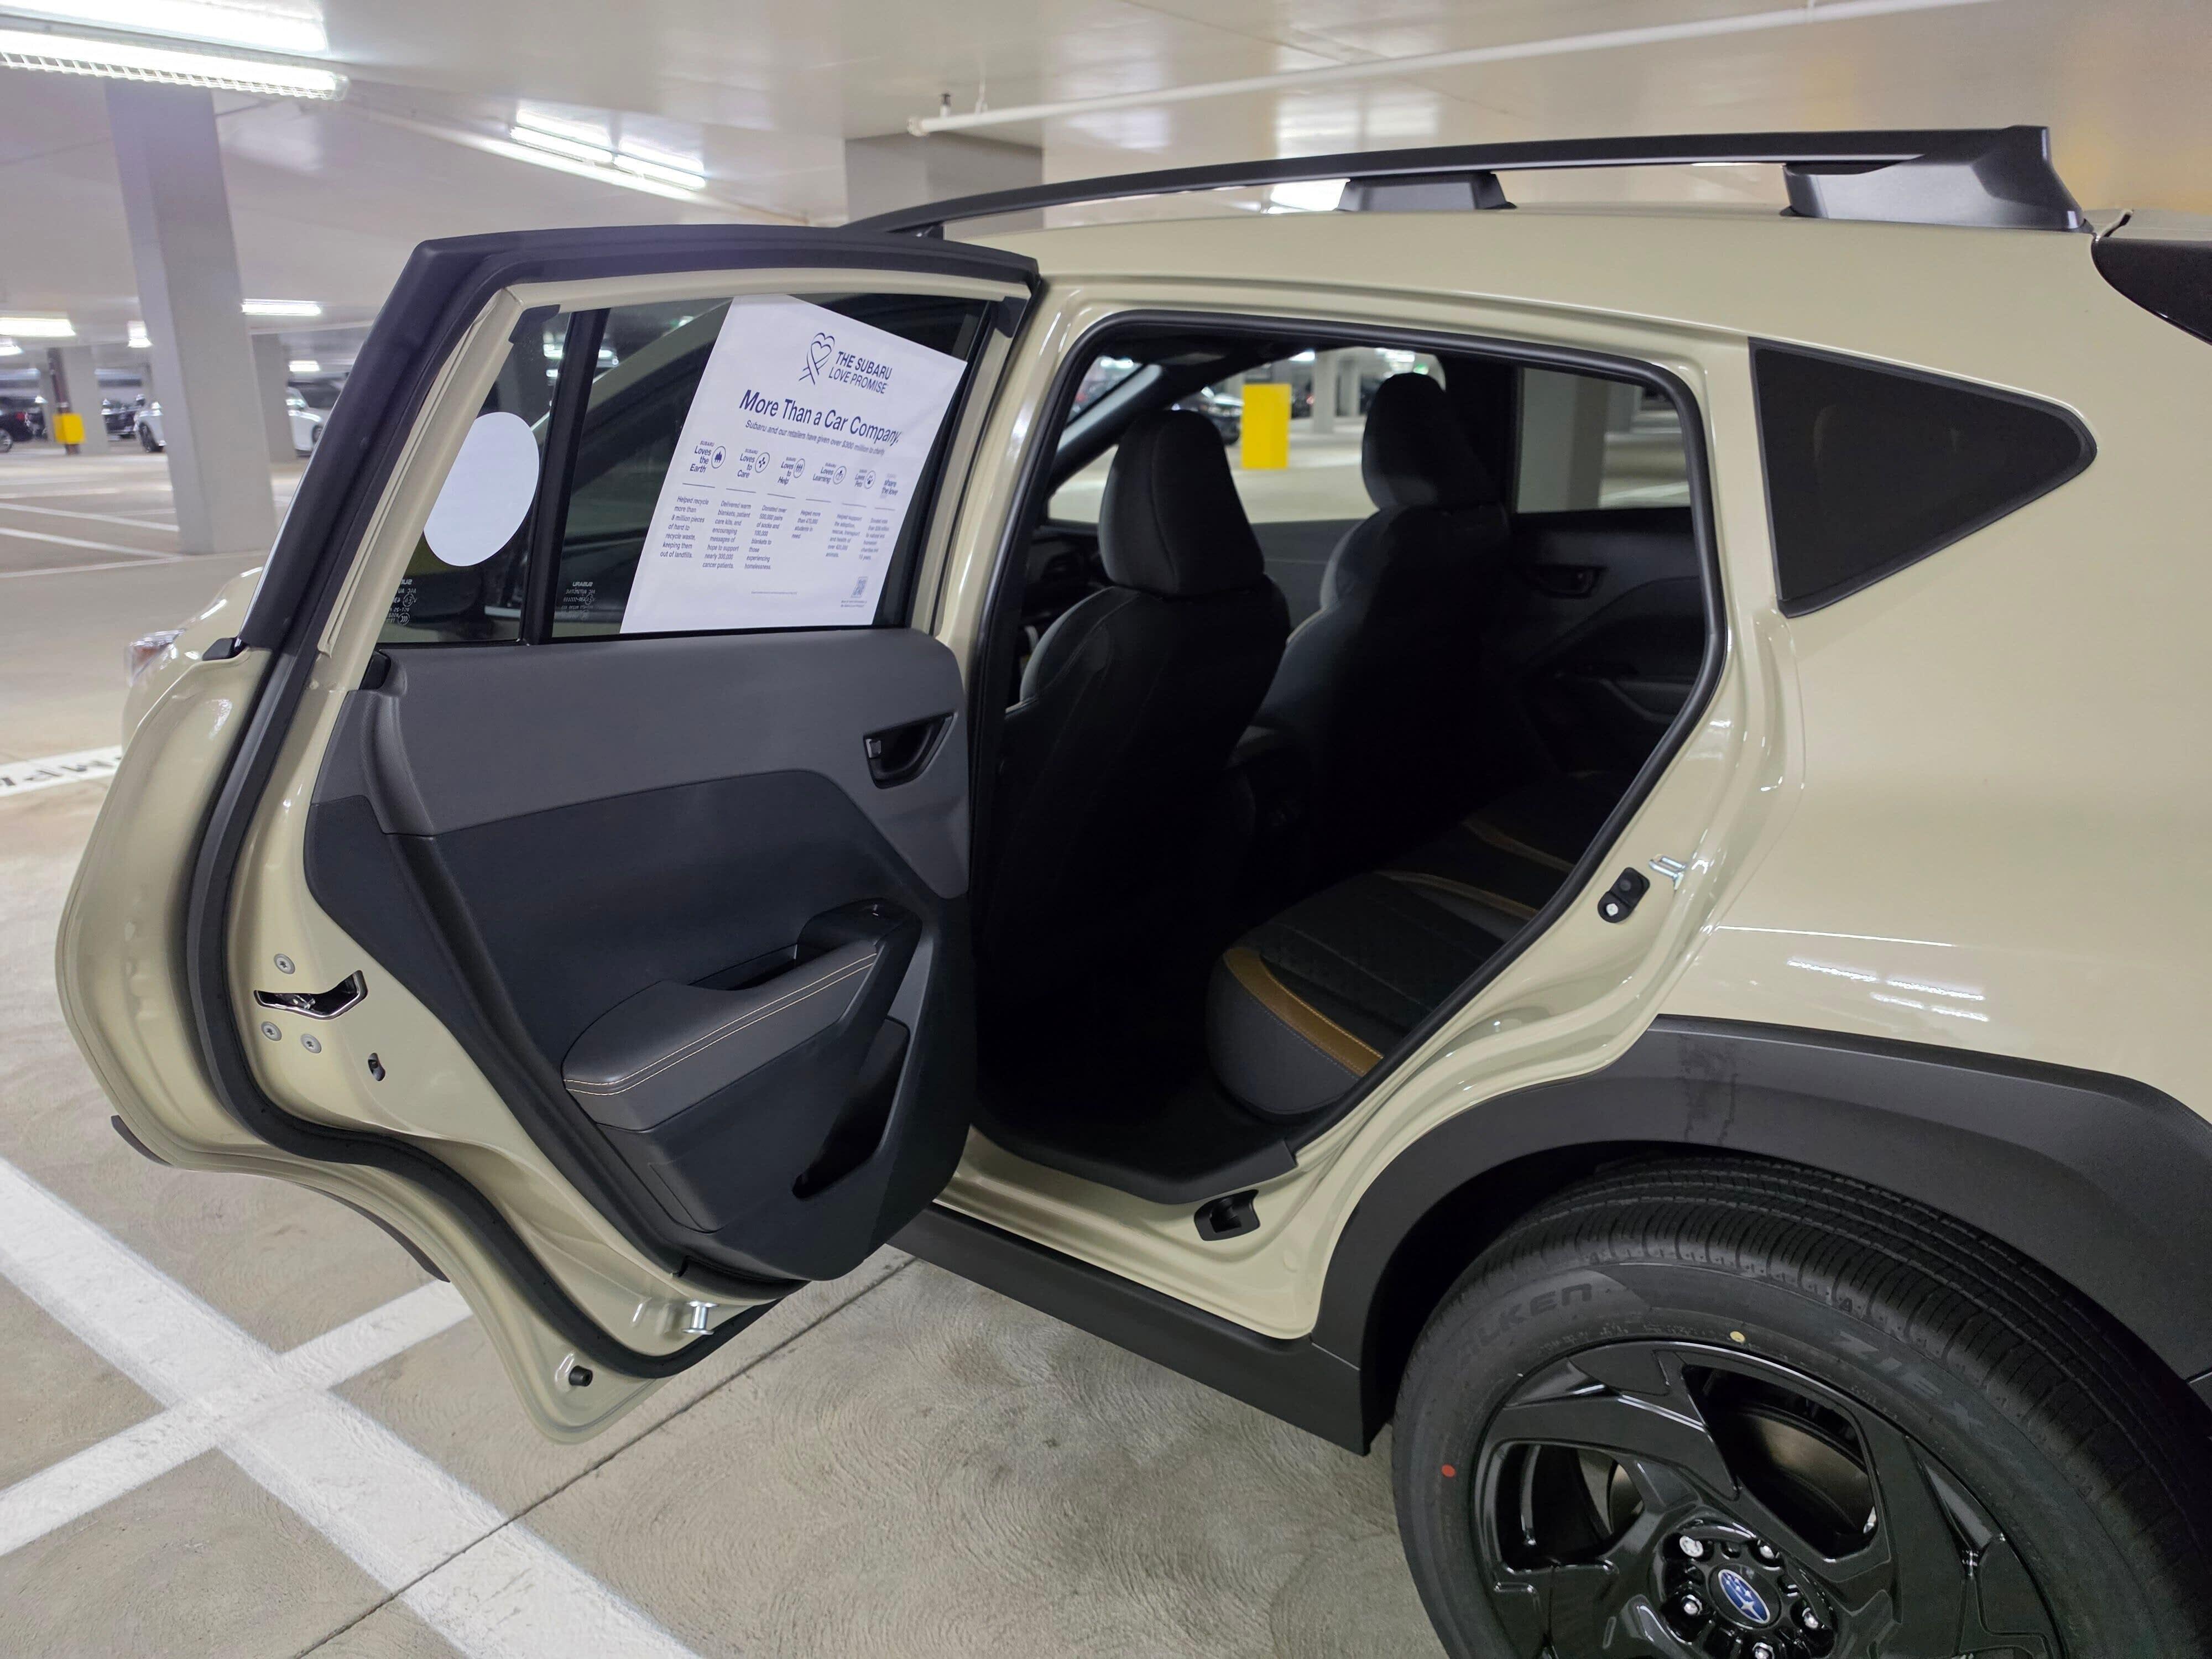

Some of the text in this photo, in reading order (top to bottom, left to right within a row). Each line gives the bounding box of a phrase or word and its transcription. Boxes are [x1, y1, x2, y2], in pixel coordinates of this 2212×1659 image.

[835, 351, 893, 380] THE SUBARU
[828, 367, 887, 394] LOVE PROMISE
[739, 389, 779, 417] More
[782, 398, 812, 424] Than
[813, 411, 822, 426] a
[824, 409, 848, 431] Car
[745, 420, 768, 432] Subaru
[787, 430, 806, 439] retailers
[806, 432, 817, 441] have
[816, 435, 830, 444] given
[694, 446, 712, 456] Loves
[700, 456, 709, 465] the
[740, 453, 755, 463] Loves
[690, 463, 706, 474] Earth
[781, 461, 794, 469] Loves
[737, 469, 750, 478] Care
[820, 467, 833, 475] Loves
[778, 476, 789, 486] Help
[812, 473, 832, 484] Learning
[677, 495, 693, 504] Helped
[712, 527, 737, 535] encouraging
[662, 541, 681, 550] keeping
